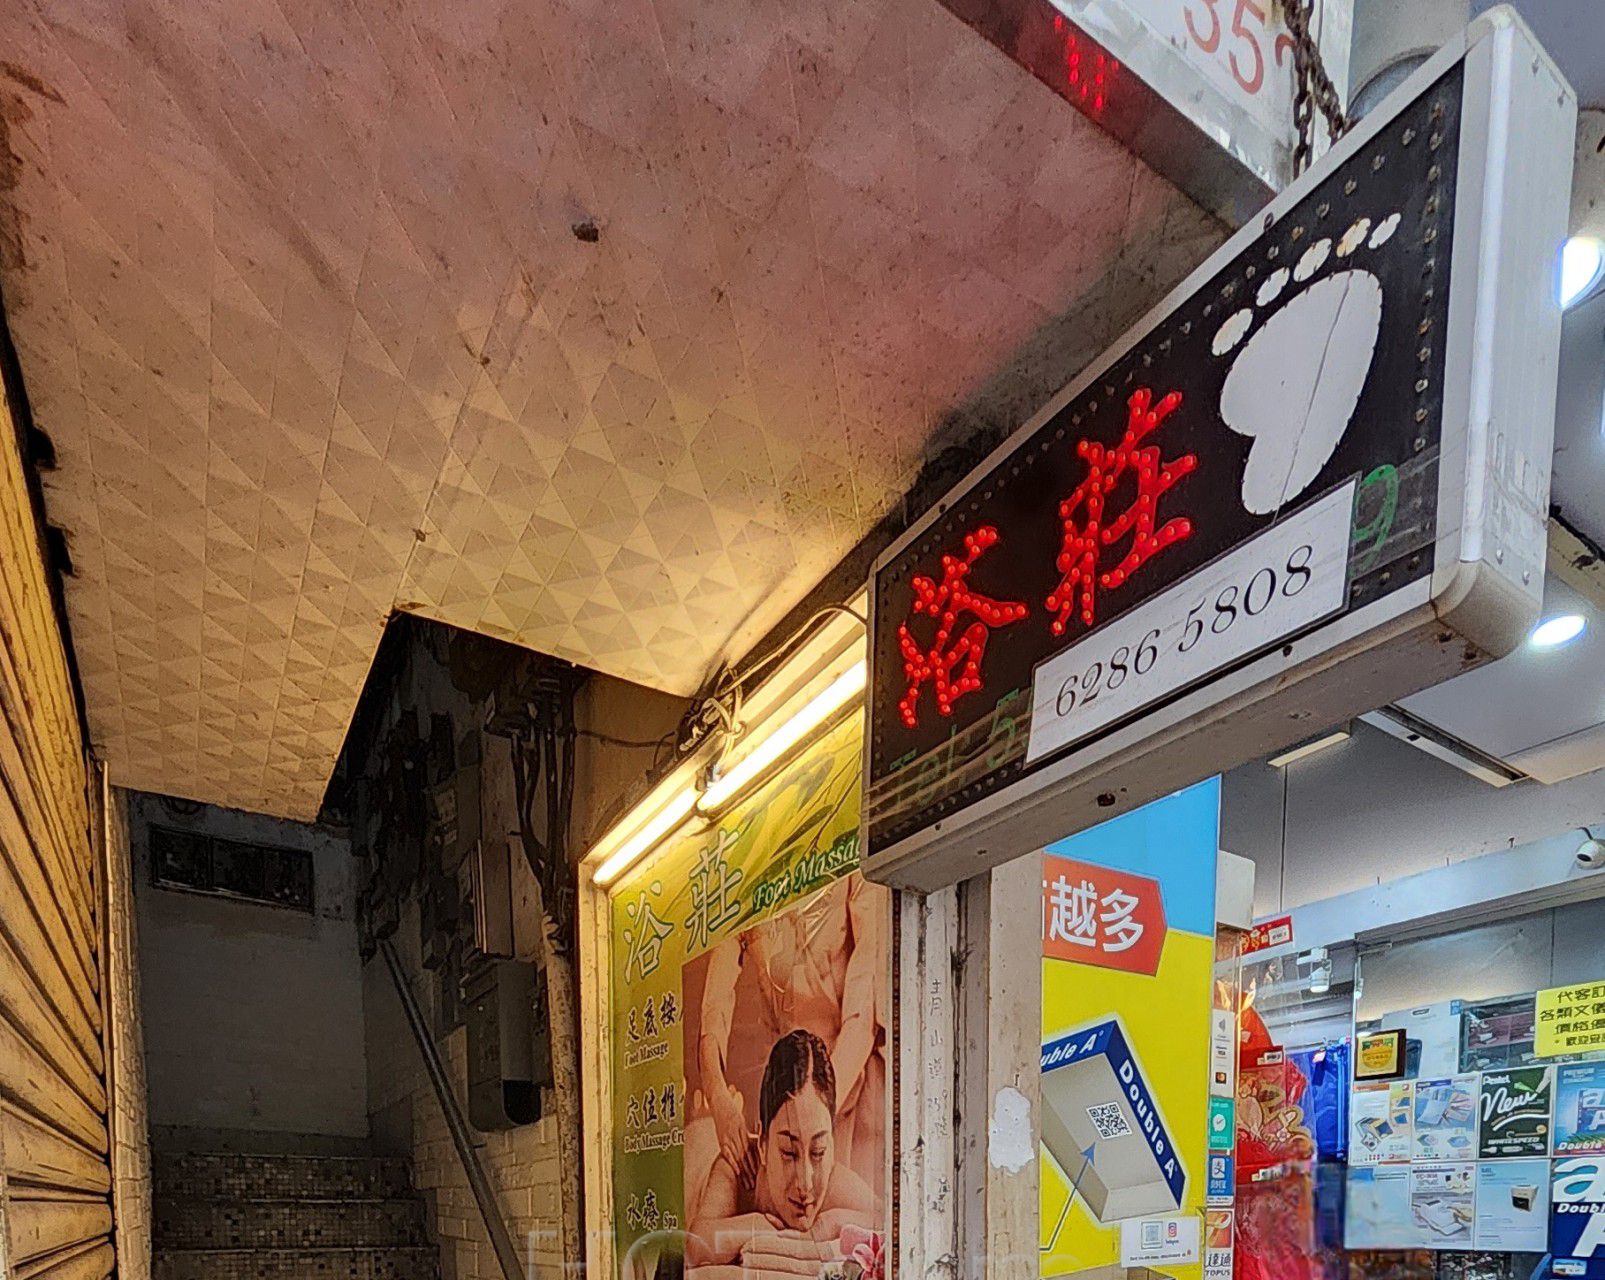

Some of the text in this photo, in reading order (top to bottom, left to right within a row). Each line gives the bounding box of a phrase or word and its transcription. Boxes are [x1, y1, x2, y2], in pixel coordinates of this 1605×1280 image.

[1055, 545, 1314, 718] 6286 5808
[753, 869, 792, 913] Foot
[1042, 875, 1143, 952] 越多
[627, 990, 683, 1042] 足底按
[626, 1083, 685, 1129] 穴位推
[1119, 1059, 1164, 1156] Double
[1480, 1087, 1538, 1122] New
